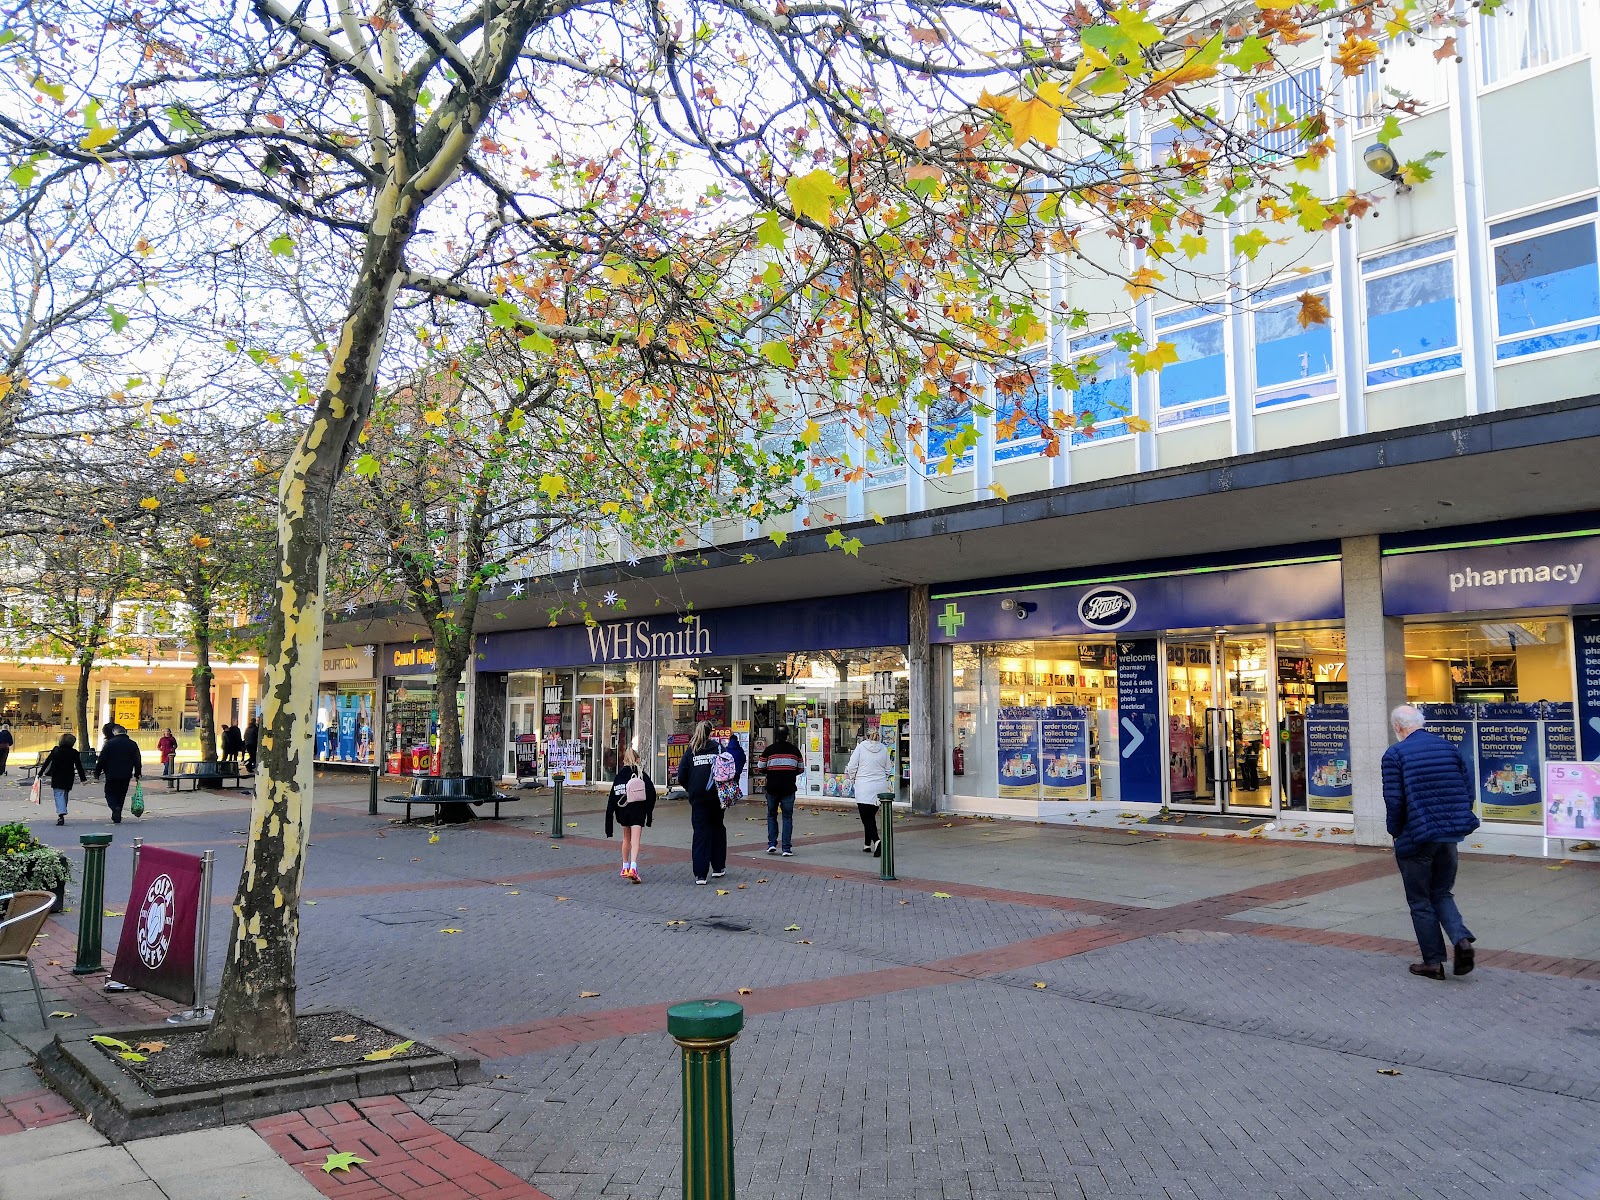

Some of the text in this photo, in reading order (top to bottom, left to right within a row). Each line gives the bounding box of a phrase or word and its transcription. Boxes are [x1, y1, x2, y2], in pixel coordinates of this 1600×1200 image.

[1450, 564, 1584, 592] pharmacy
[1086, 595, 1124, 619] Boots
[586, 615, 713, 662] WHSmith
[394, 649, 414, 666] Card
[1119, 654, 1156, 662] welcome
[324, 658, 358, 671] BURTON
[1119, 664, 1146, 672] pharmacy
[1120, 672, 1138, 680] beauty
[866, 672, 897, 694] HALF
[544, 687, 562, 703] HALF
[869, 695, 896, 709] PRICE
[546, 704, 560, 714] PRICE
[1329, 725, 1349, 733] today,
[1442, 725, 1466, 733] today,
[1505, 726, 1530, 734] today,
[517, 743, 536, 754] HALF
[670, 757, 680, 766] PRI
[1552, 768, 1564, 778] £5
[148, 878, 172, 907] COSTA
[140, 928, 168, 966] COFFEE
